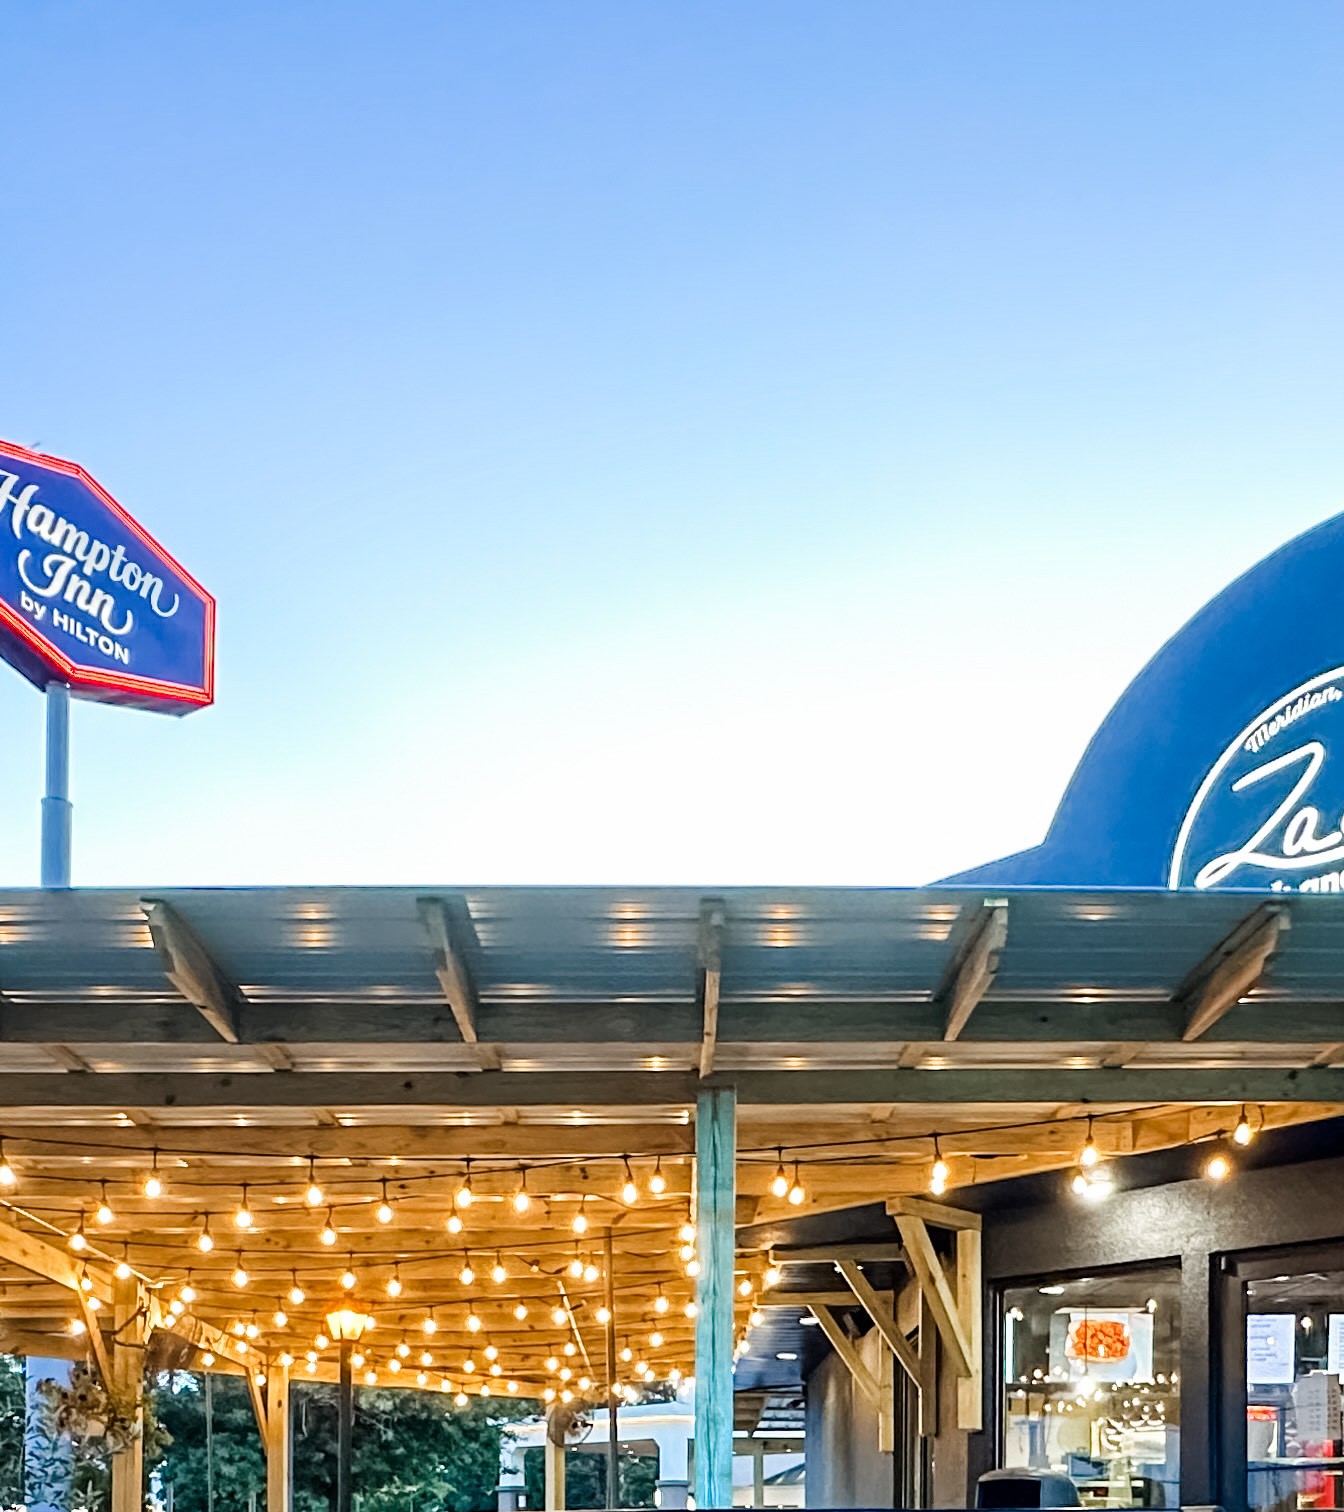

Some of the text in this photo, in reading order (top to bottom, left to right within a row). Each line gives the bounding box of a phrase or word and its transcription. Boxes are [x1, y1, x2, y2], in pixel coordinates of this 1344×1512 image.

[17, 549, 134, 636] Inn
[20, 591, 130, 665] by HILTON
[1244, 686, 1343, 753] Meridian,
